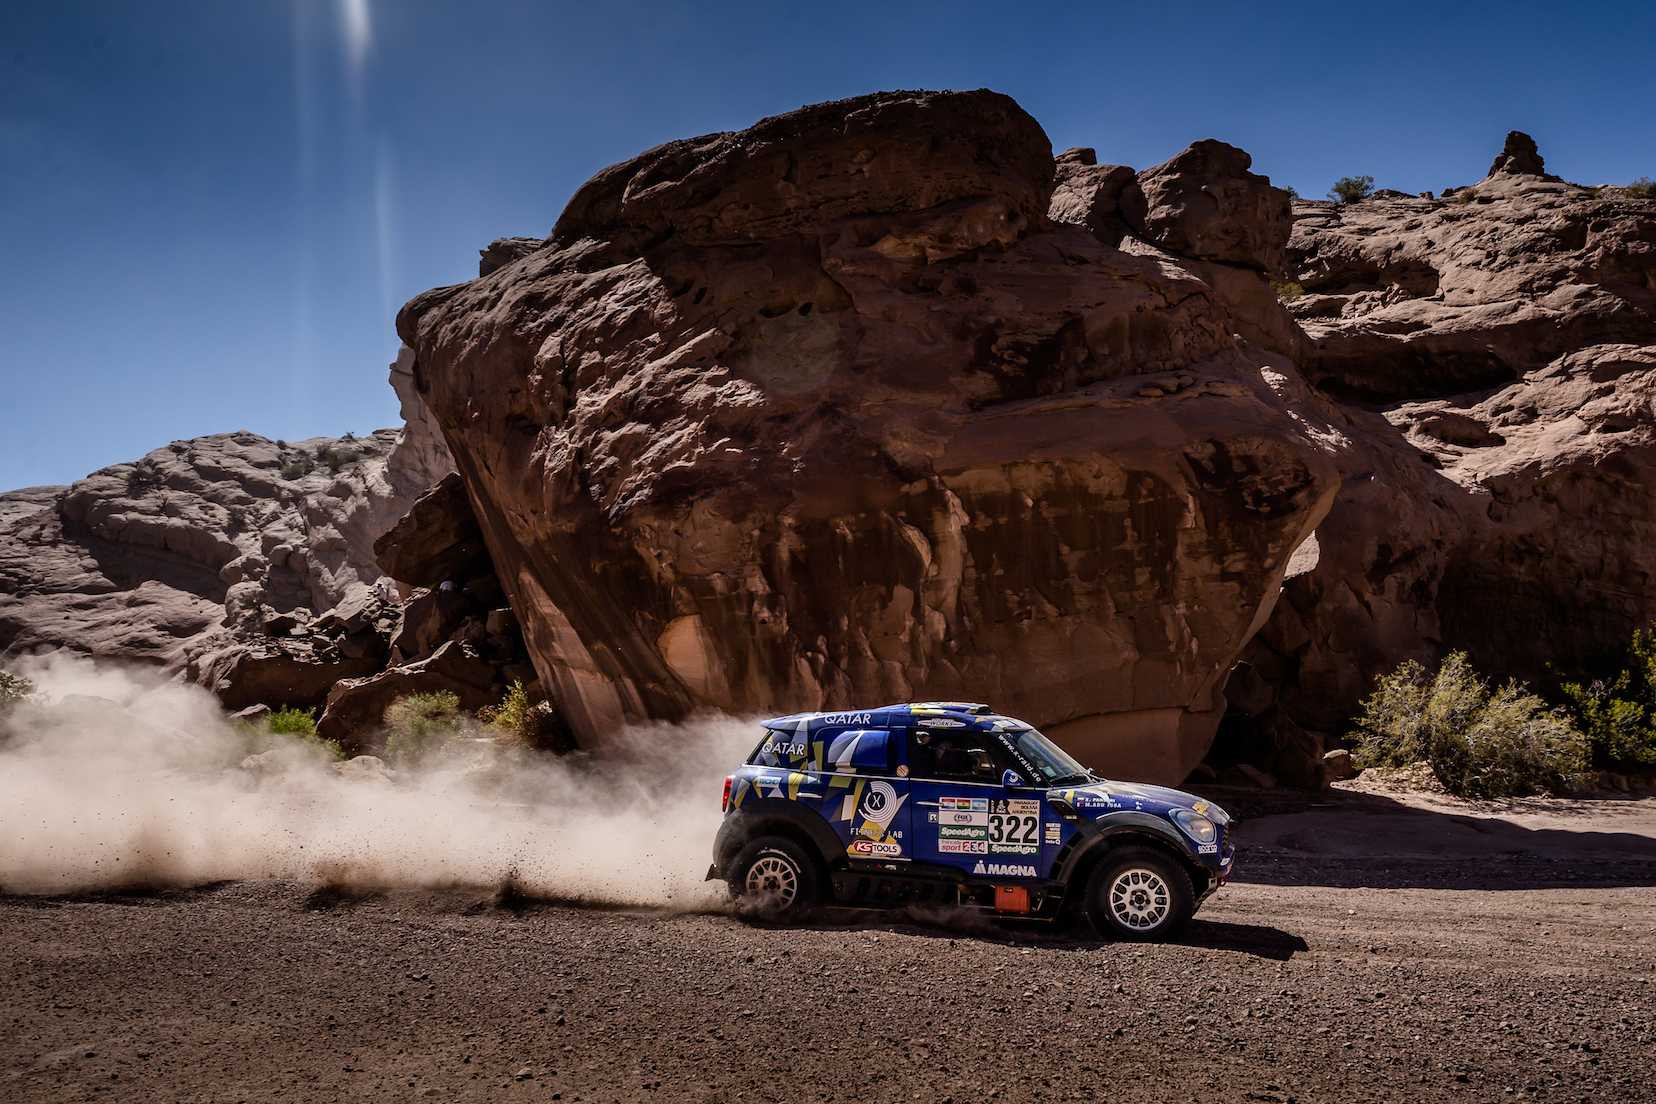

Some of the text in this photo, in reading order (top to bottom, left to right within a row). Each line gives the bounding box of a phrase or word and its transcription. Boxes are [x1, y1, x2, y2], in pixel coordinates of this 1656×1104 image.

[825, 713, 871, 725] QATAR
[761, 742, 805, 756] QATAR
[941, 828, 986, 838] SpeedAgro
[989, 815, 1038, 843] 322
[856, 842, 897, 852] KS TOOLS
[991, 845, 1036, 854] SpeedAgro
[988, 864, 1037, 876] MAGNA
